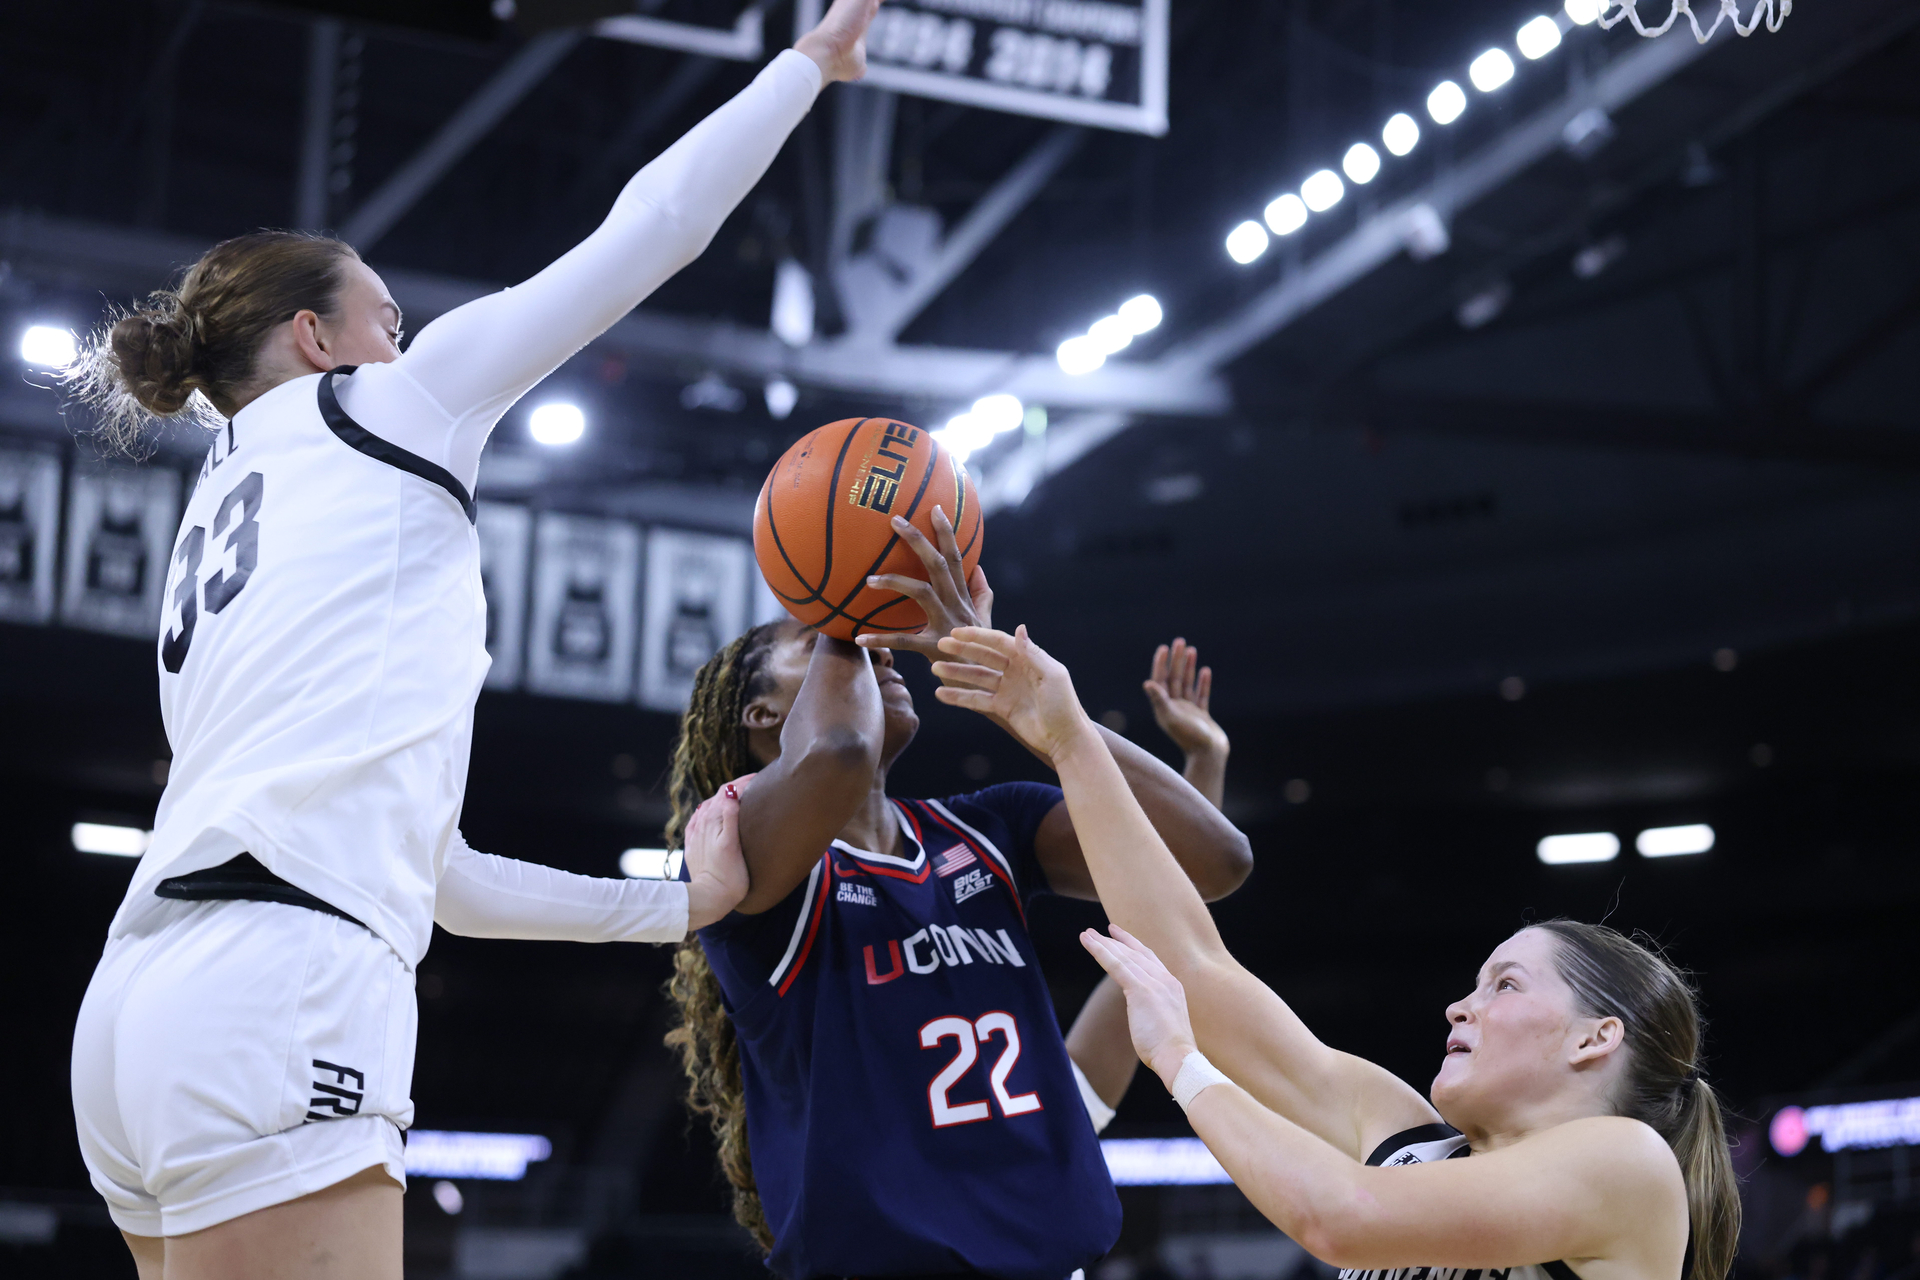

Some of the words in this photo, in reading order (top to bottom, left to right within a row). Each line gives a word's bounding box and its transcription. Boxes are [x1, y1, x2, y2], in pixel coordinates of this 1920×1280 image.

[857, 422, 920, 516] ELITE
[162, 471, 264, 674] 33
[837, 890, 877, 907] CHANGE
[840, 882, 854, 893] BE
[856, 884, 875, 897] THE
[954, 868, 981, 890] BIG
[954, 873, 994, 900] EAST
[863, 923, 1026, 985] UCONN
[917, 1009, 1044, 1129] 22
